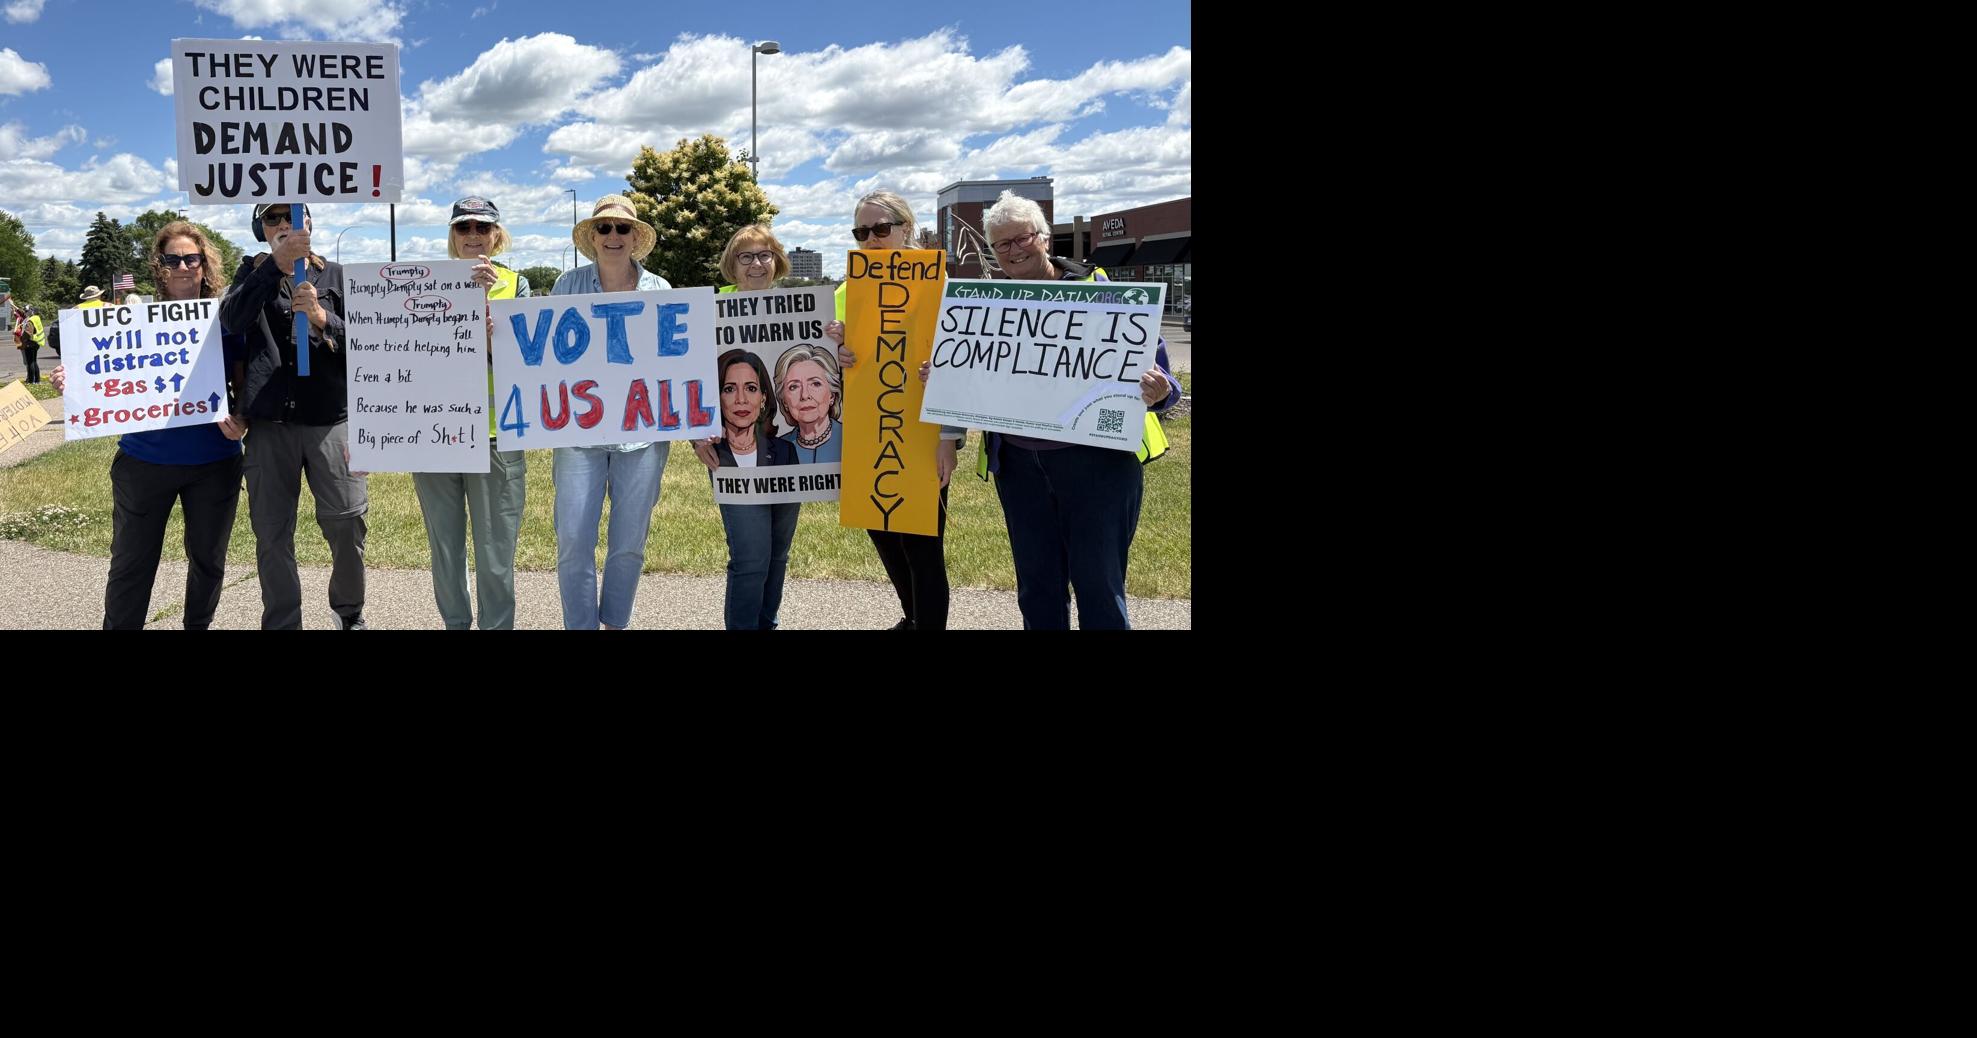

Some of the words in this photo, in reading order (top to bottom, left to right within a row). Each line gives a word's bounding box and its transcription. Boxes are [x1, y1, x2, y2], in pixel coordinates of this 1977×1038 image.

[185, 52, 278, 78] THEY
[292, 54, 384, 79] WERE
[199, 86, 369, 111] CHILDREN
[193, 122, 352, 155] DEMAND
[1103, 218, 1124, 230] AVEDA
[385, 266, 424, 277] Trumpty
[849, 250, 942, 281] Defend
[348, 278, 386, 299] Humpty
[424, 280, 437, 291] sat
[441, 282, 452, 290] on
[1011, 289, 1034, 300] UP
[83, 306, 132, 327] UFC
[148, 302, 211, 323] FIGHT
[411, 299, 447, 312] Trumpty
[716, 297, 759, 319] THEY
[763, 293, 816, 316] TRIED
[348, 311, 373, 324] When
[375, 312, 410, 328] Humpty
[443, 310, 468, 326] began
[472, 310, 480, 321] to
[941, 306, 1088, 340] SILENCE
[1101, 311, 1149, 346] IS
[92, 329, 142, 350] will
[156, 327, 199, 346] not
[453, 326, 472, 340] fall
[510, 301, 690, 367] VOTE
[716, 325, 734, 345] TO
[739, 323, 794, 343] WARN
[799, 320, 823, 340] US
[384, 340, 409, 352] tried
[414, 342, 450, 357] helping
[456, 342, 476, 353] him
[933, 338, 1144, 383] COMPLIANCE
[85, 348, 189, 375] distract
[354, 367, 379, 383] Even
[385, 373, 391, 383] a
[398, 369, 413, 383] bit
[103, 378, 148, 397] gas
[84, 399, 208, 427] groceries
[357, 397, 398, 413] Because
[406, 400, 417, 413] he
[423, 404, 443, 413] was
[448, 403, 471, 414] such
[474, 406, 482, 414] a
[500, 384, 530, 438] 4
[540, 379, 604, 431] US
[622, 378, 715, 431] ALL
[870, 282, 910, 530] DEMOCRACY
[358, 428, 375, 449] Big
[381, 433, 403, 450] piece
[408, 430, 421, 444] of
[717, 477, 750, 494] THEY
[753, 476, 795, 494] WERE
[799, 473, 841, 491] RIGHT
